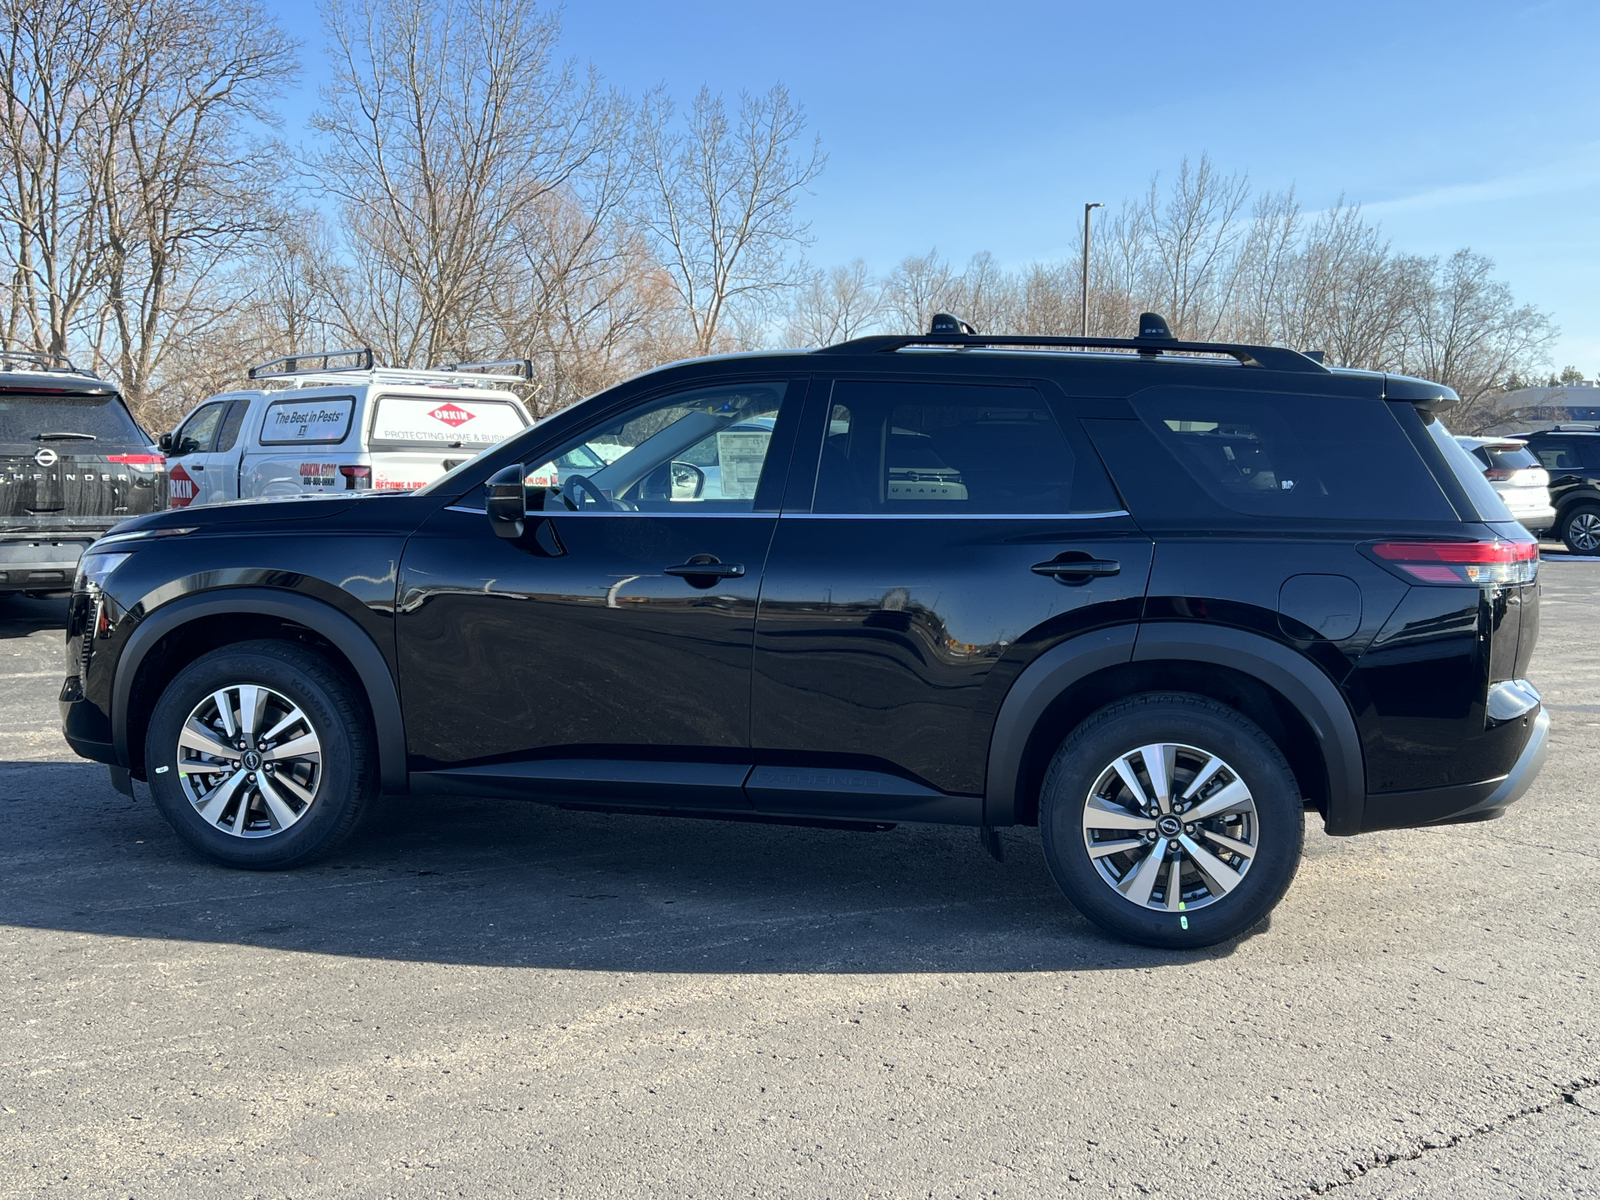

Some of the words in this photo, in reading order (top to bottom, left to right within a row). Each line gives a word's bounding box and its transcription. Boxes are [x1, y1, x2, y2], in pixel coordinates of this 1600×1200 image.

[275, 412, 290, 424] The
[289, 411, 309, 424] Best
[308, 410, 317, 422] in
[433, 410, 469, 420] ORKIN
[384, 430, 445, 441] PROTECTING
[446, 432, 472, 442] HOME
[473, 433, 480, 441] &
[300, 463, 337, 477] ORKIN.COM
[169, 479, 192, 498] RKIN
[291, 678, 332, 729] KUMHO
